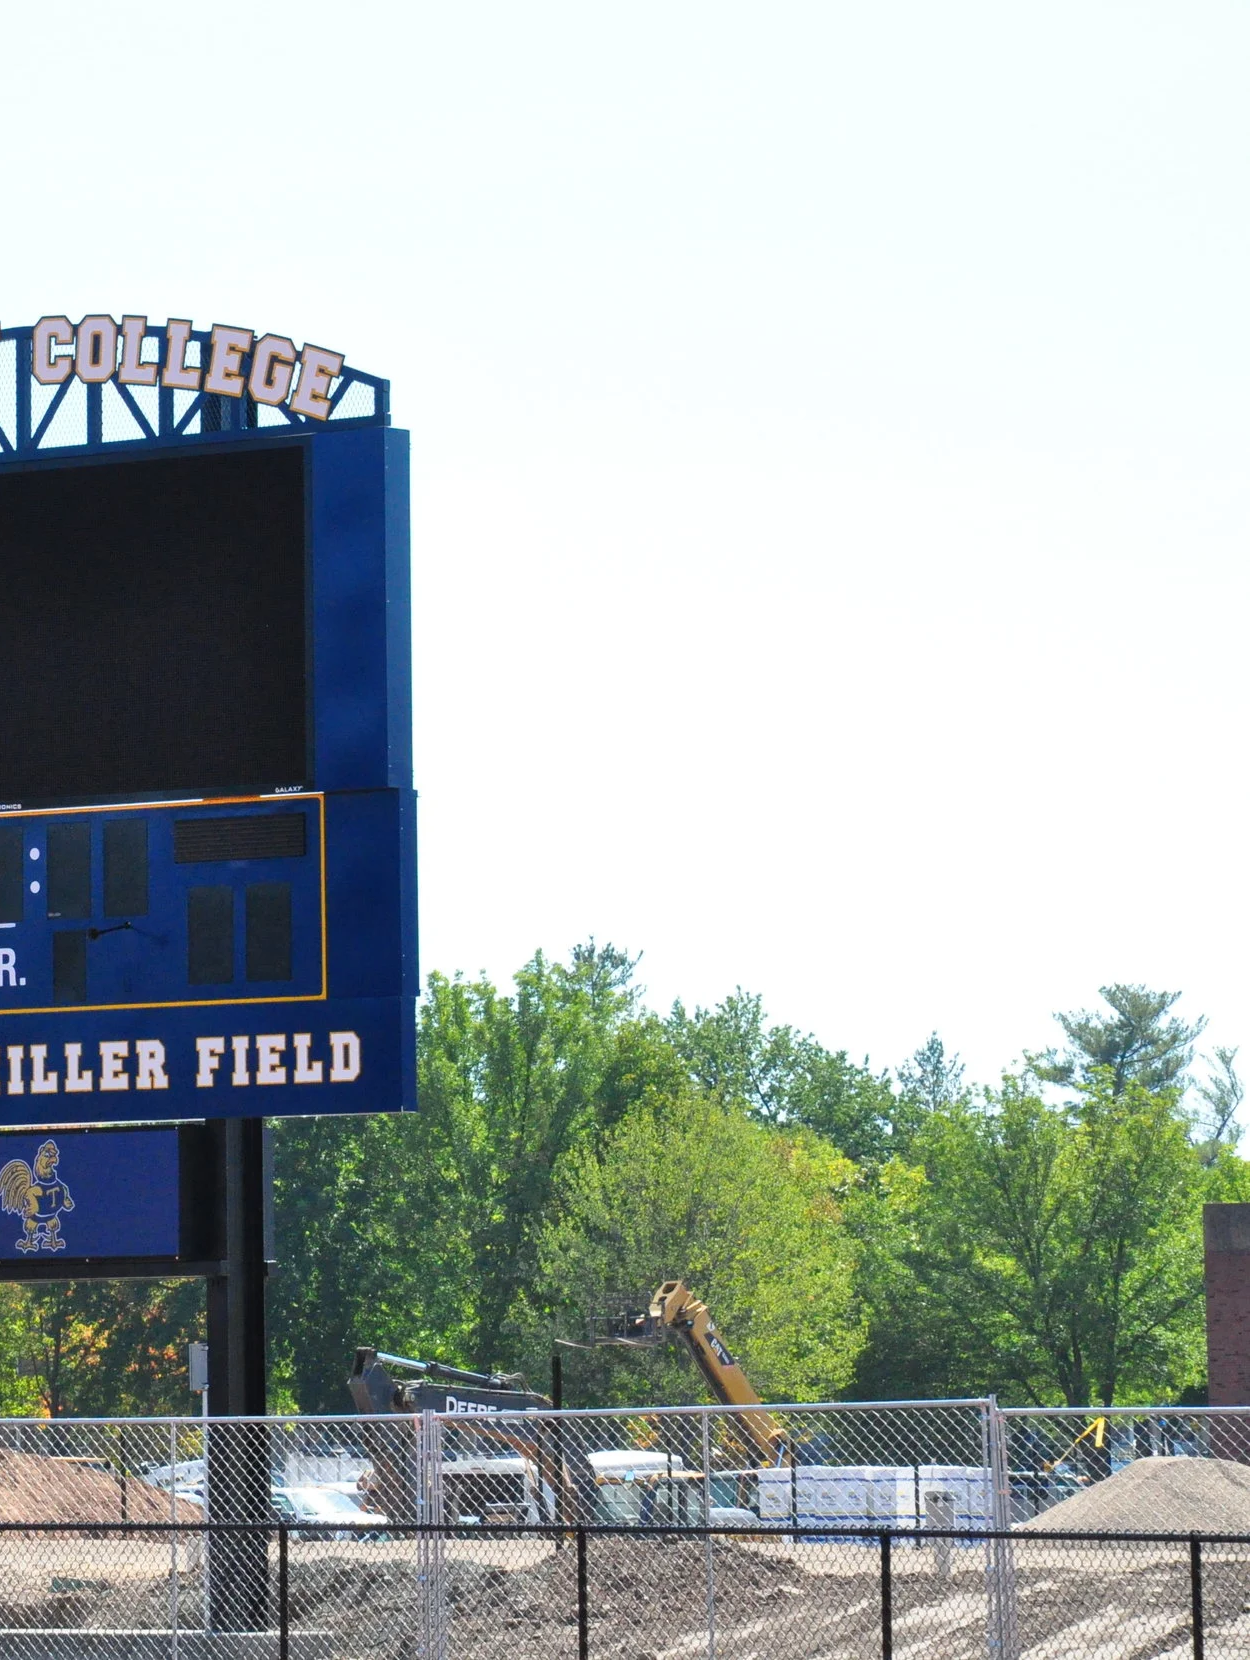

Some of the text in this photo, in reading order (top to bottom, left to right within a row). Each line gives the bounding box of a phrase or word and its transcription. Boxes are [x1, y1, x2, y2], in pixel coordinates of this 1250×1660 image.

[32, 314, 345, 421] COLLEGE
[275, 785, 302, 793] GALAXY
[195, 1031, 361, 1088] FIELD
